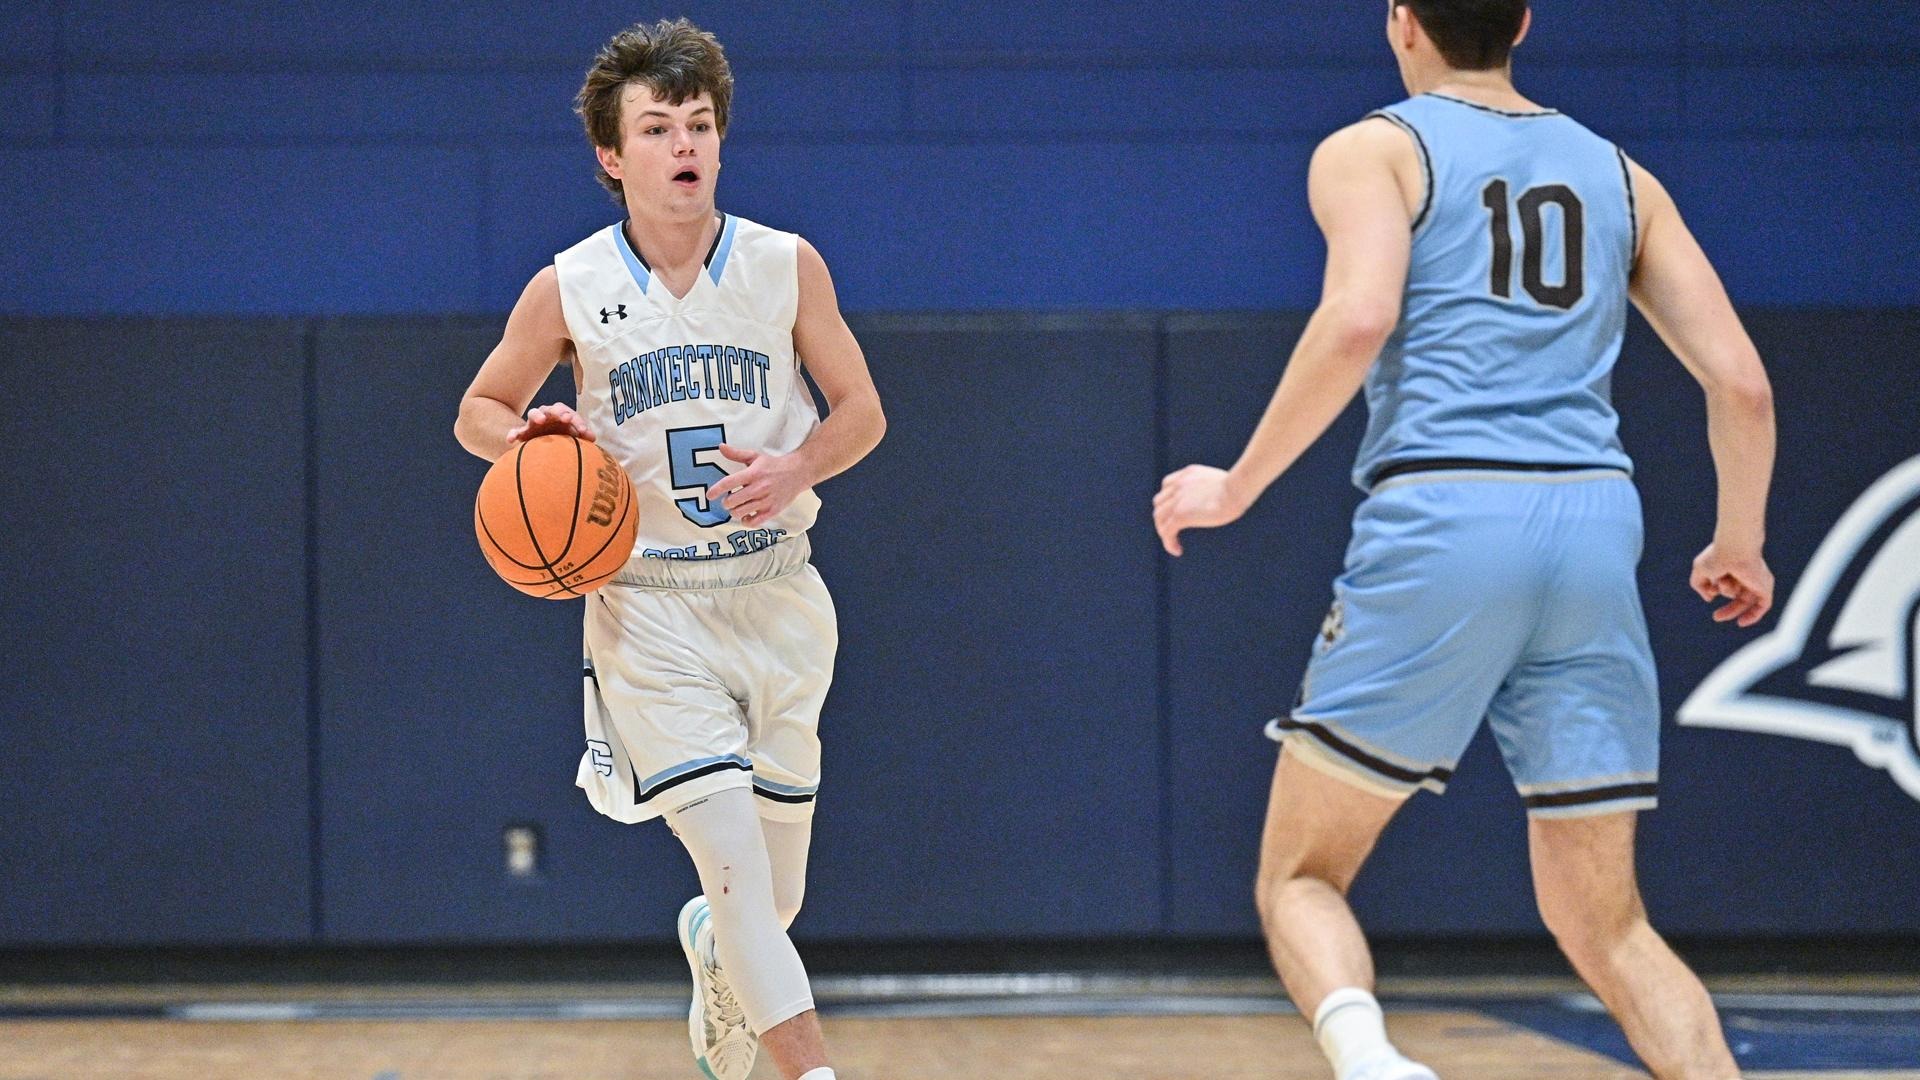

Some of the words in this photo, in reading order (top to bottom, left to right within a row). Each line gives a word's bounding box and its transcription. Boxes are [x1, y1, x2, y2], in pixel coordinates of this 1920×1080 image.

[1481, 177, 1585, 311] 10
[608, 344, 771, 426] CONNECTICUT
[586, 444, 619, 527] Wilso
[665, 423, 732, 528] 5
